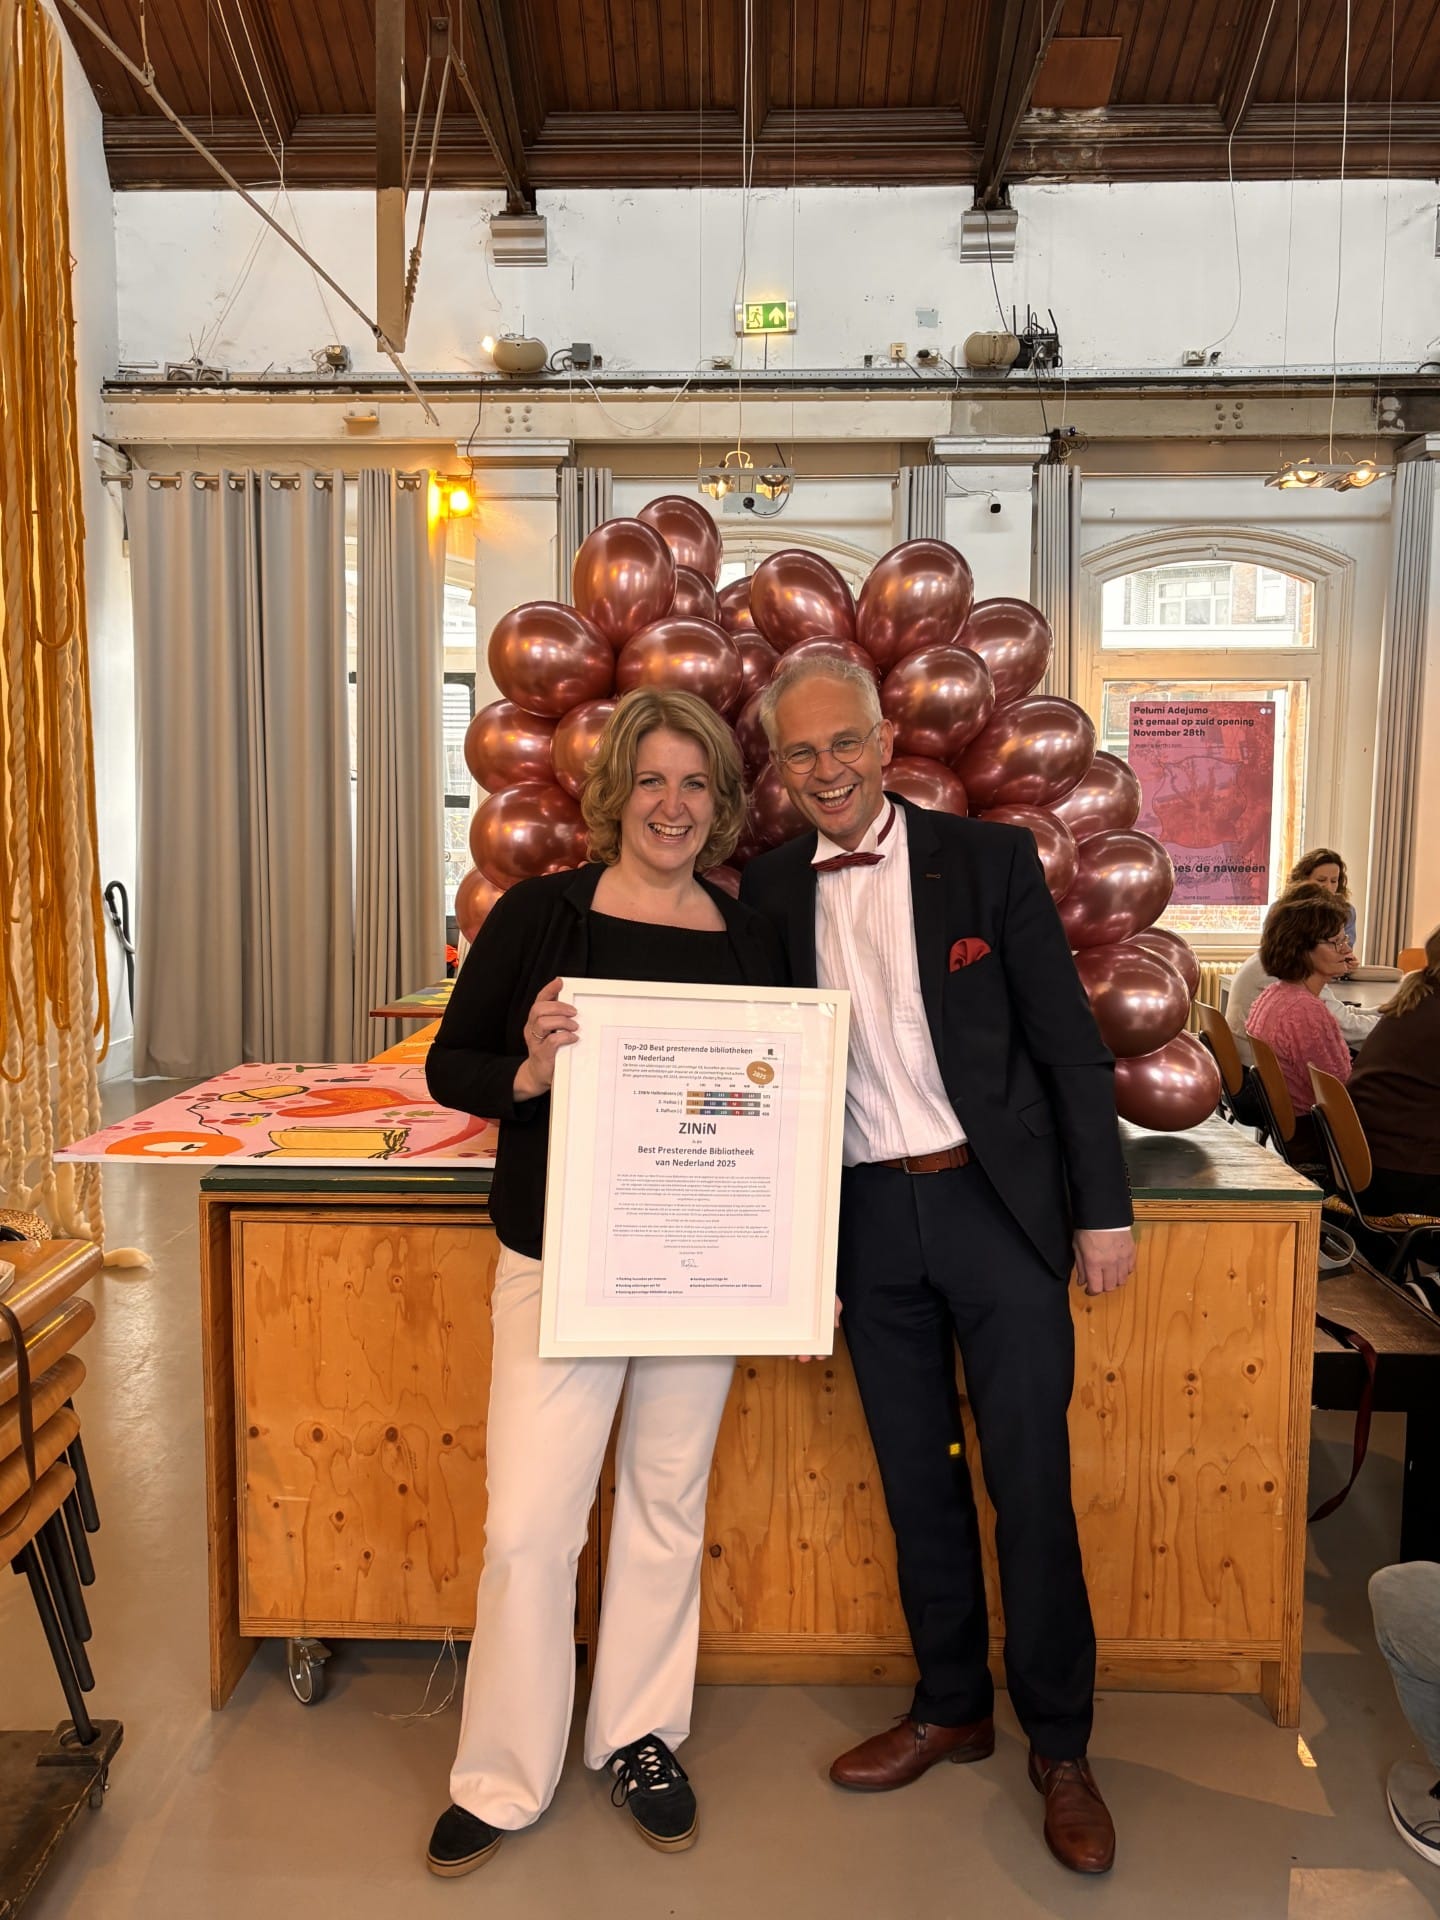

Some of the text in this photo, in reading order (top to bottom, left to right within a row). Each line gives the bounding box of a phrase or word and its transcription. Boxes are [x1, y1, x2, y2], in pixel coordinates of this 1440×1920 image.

[1133, 706, 1208, 716] Pelumi Adejumo
[1133, 718, 1254, 727] at gemaal op zuid opening
[1133, 729, 1206, 737] November 28th
[1213, 864, 1266, 873] naweeën
[624, 1043, 753, 1055] Top-20 Best presterende bibliotheken
[638, 1054, 675, 1062] Nederland
[678, 1122, 717, 1135] ZINiN
[638, 1145, 754, 1156] Best Presterende Bibliotheek
[672, 1159, 715, 1167] Nederland
[717, 1160, 736, 1168] 2025
